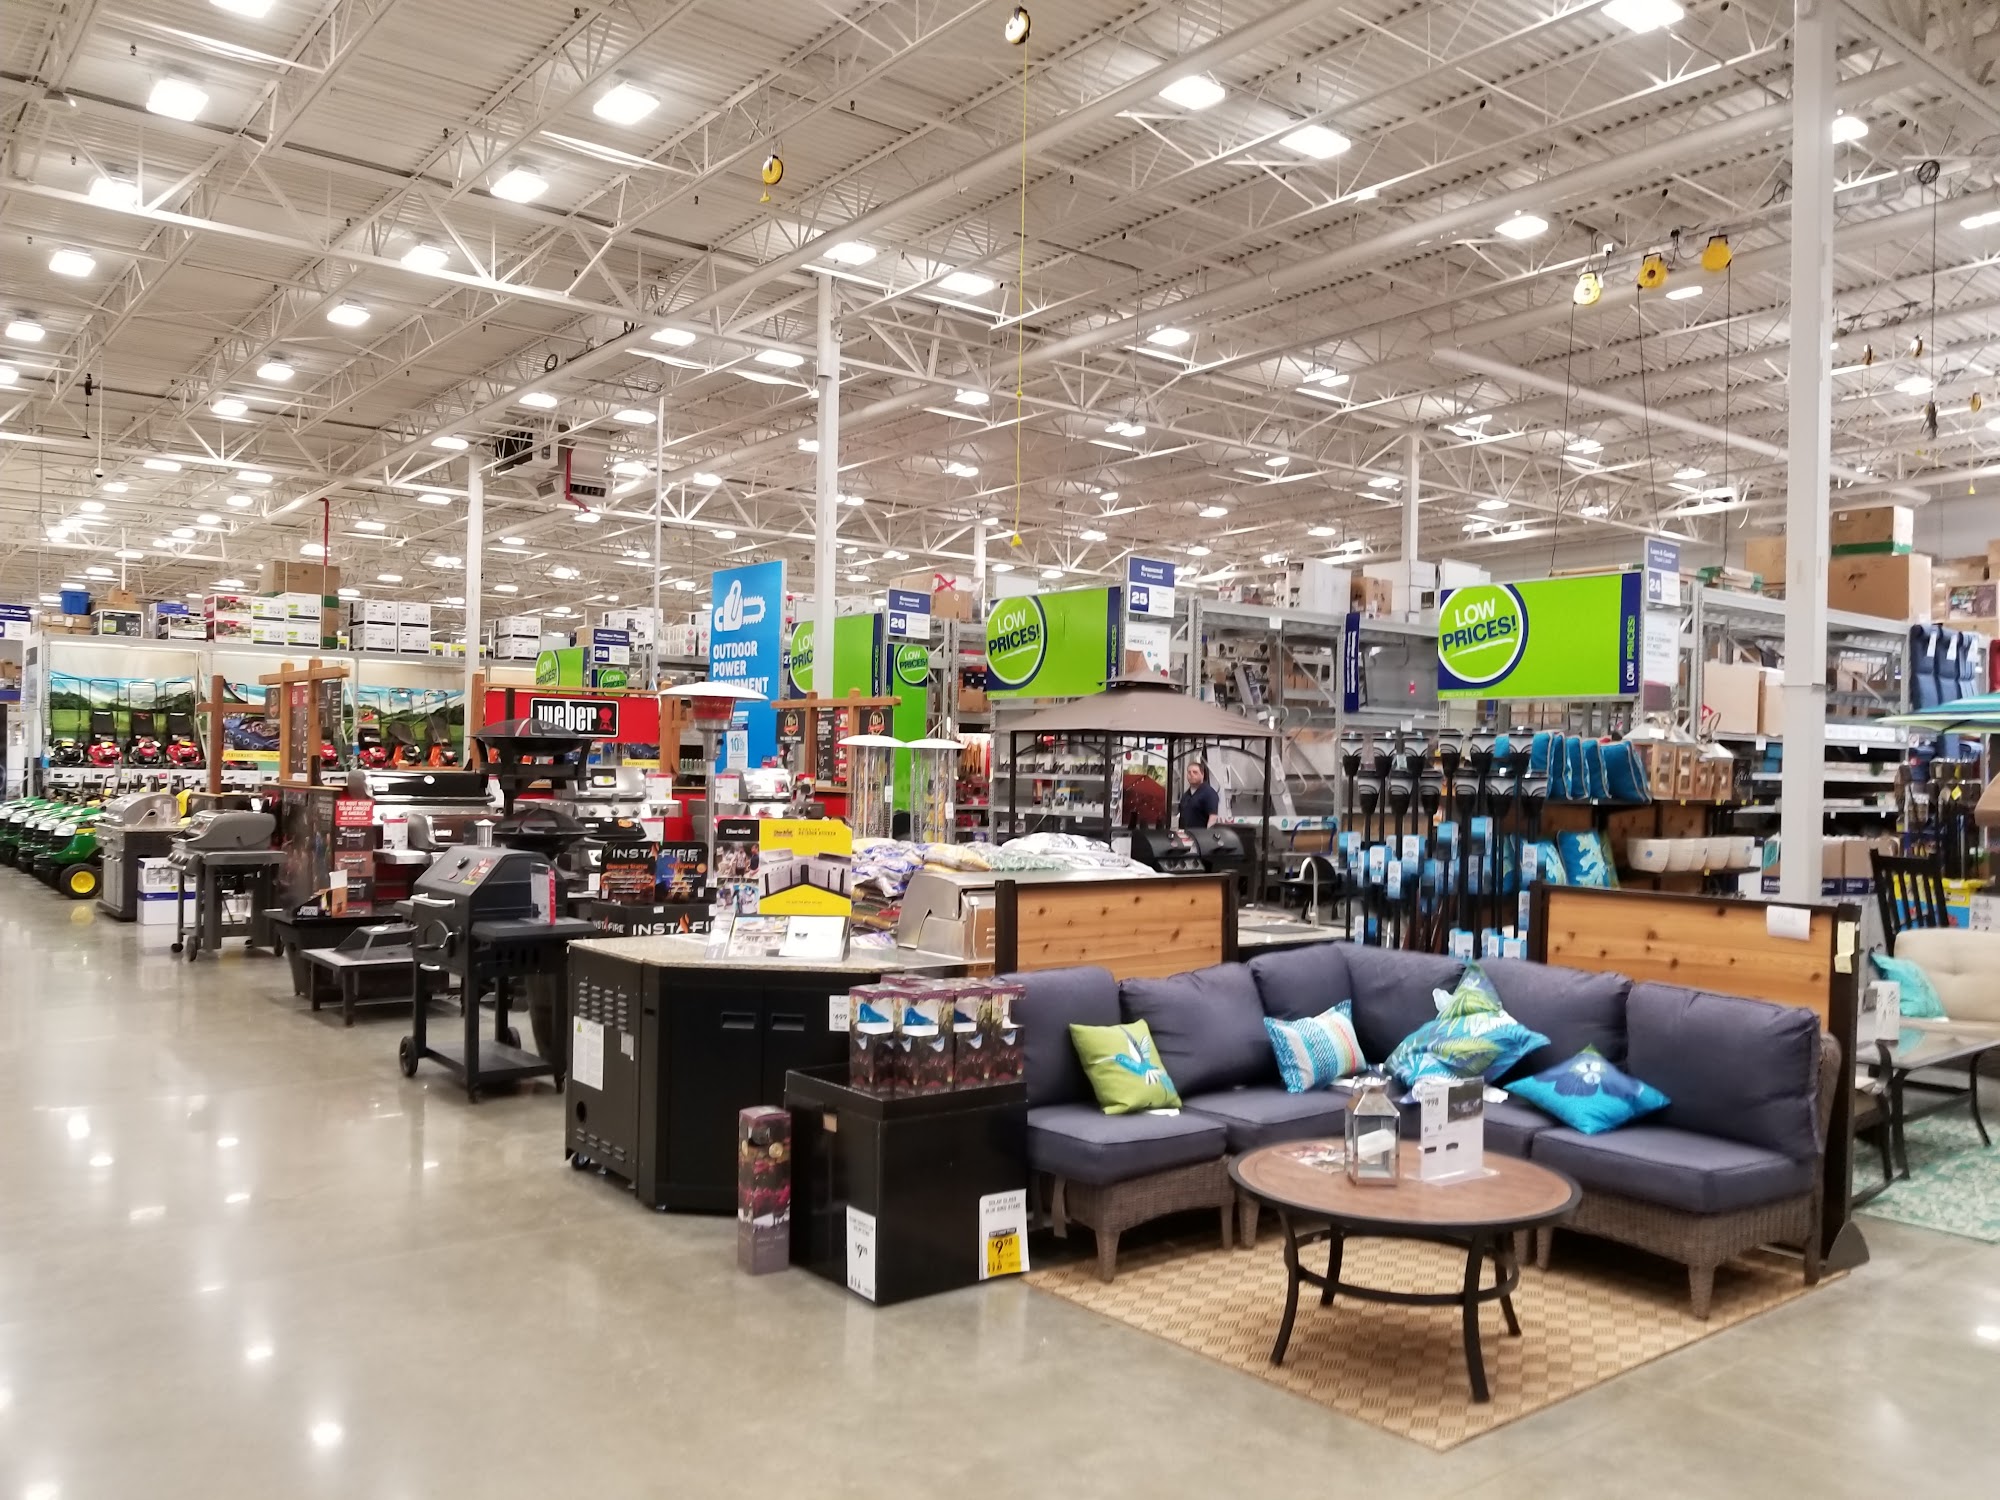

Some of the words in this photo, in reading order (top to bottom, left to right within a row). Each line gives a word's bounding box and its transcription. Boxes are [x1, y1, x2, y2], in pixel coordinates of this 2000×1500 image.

[1649, 579, 1661, 593] 24
[1131, 591, 1148, 605] 25
[997, 608, 1026, 634] LOW
[1455, 598, 1496, 627] LOW
[988, 624, 1040, 657] PRICES!
[1442, 615, 1517, 652] PRICES!
[713, 640, 758, 660] OUTDOOR
[904, 650, 920, 660] LOW
[540, 659, 552, 674] LOW
[713, 660, 746, 678] POWER
[792, 650, 814, 670] PRIC
[900, 658, 928, 669] PRICES!
[536, 668, 557, 685] PRICES!
[1626, 661, 1635, 686] LOW
[713, 677, 769, 693] PMENT
[538, 700, 597, 731] weber
